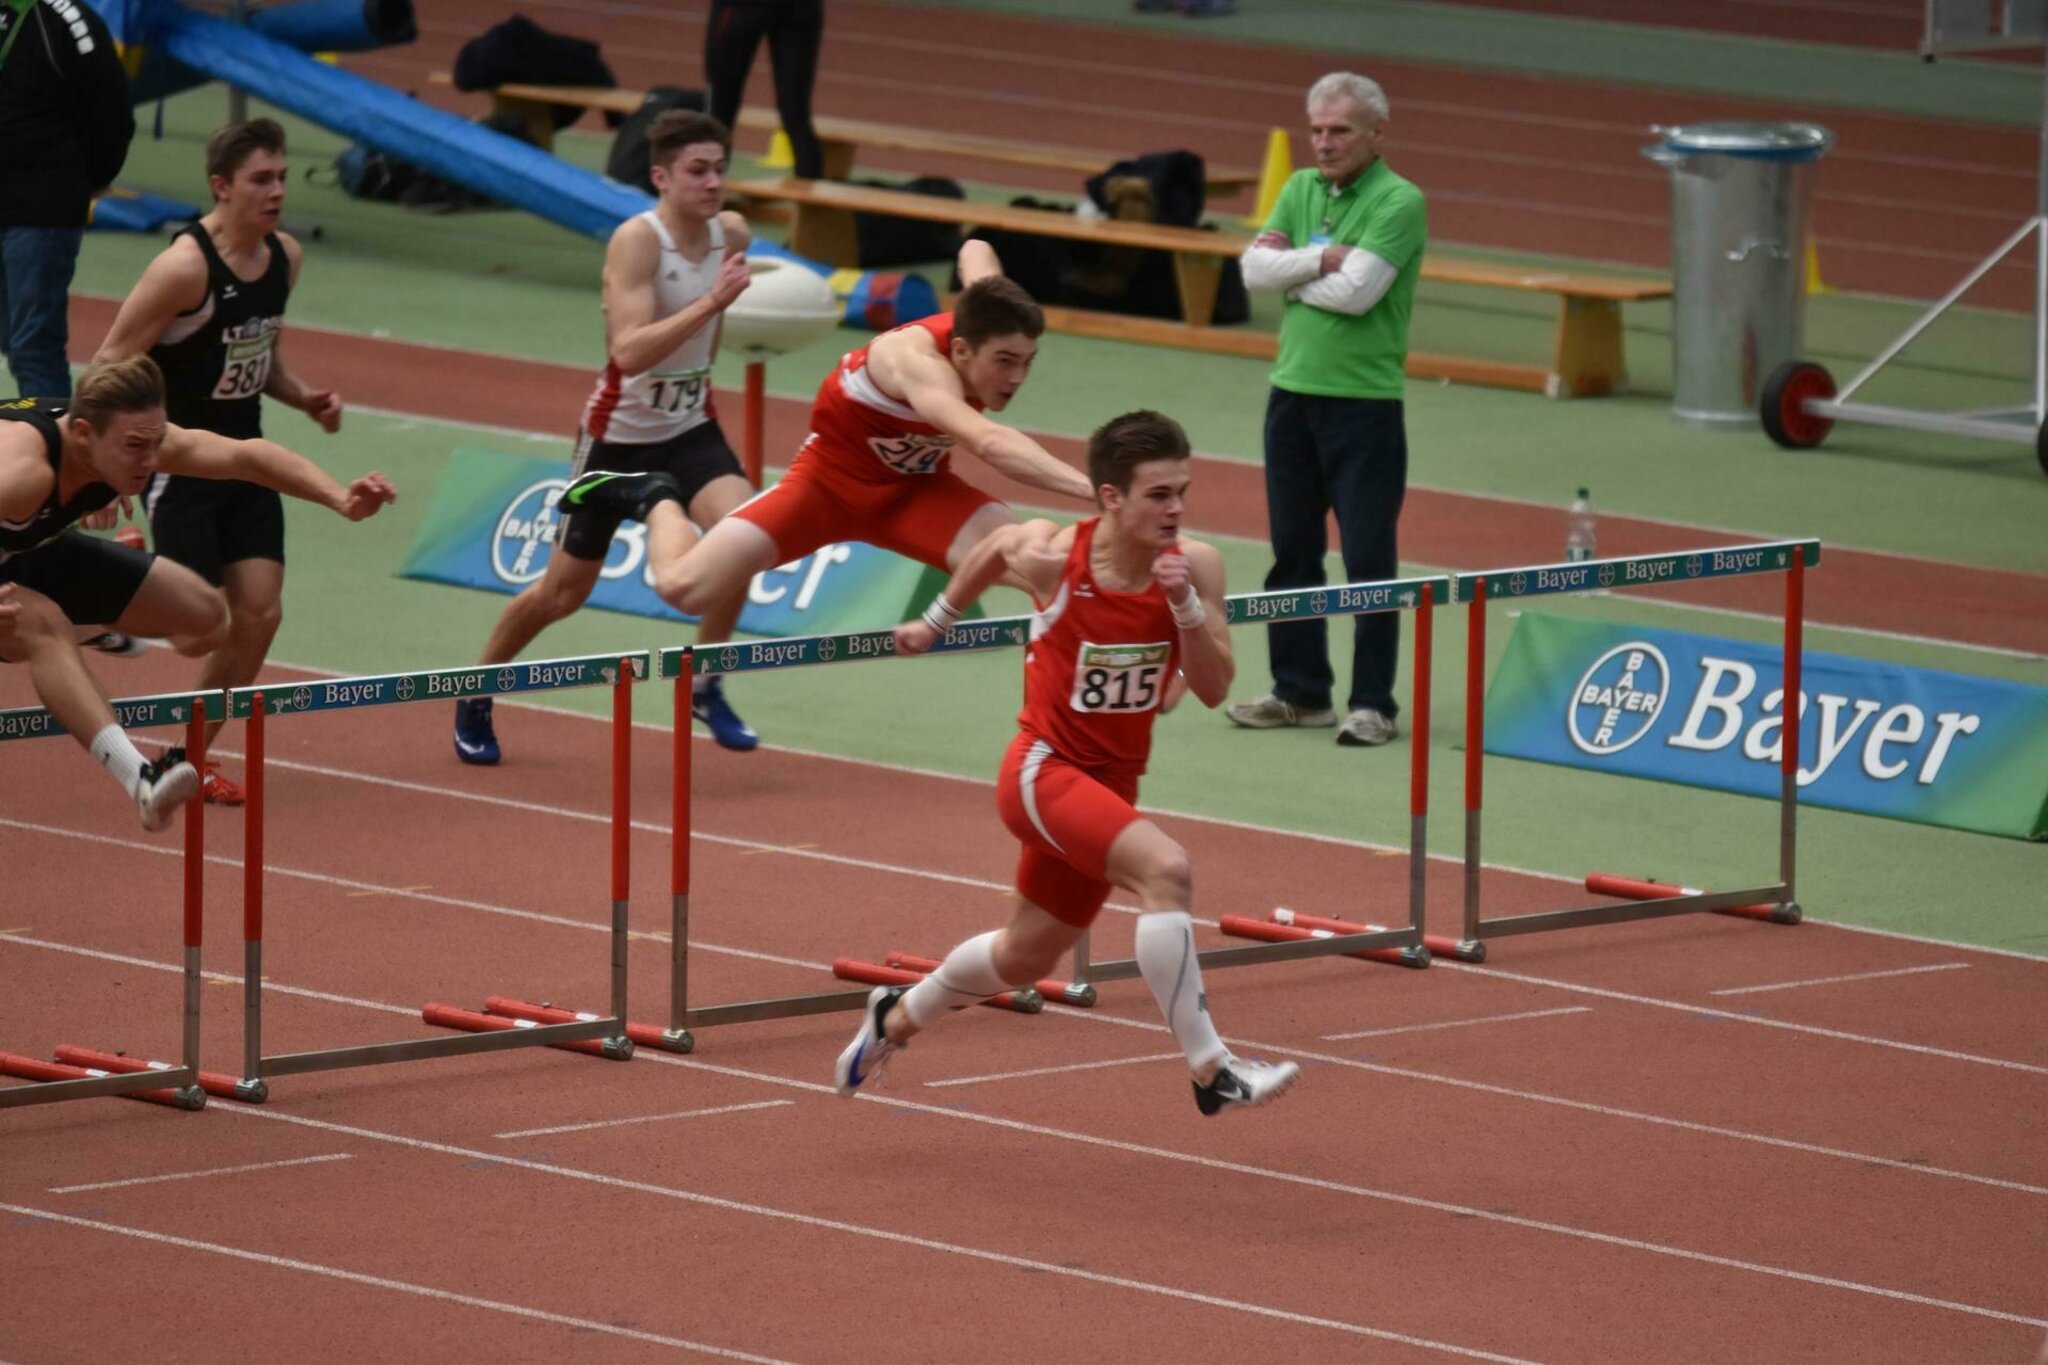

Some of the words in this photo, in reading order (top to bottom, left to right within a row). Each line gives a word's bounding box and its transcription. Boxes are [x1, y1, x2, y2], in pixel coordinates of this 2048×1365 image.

[219, 357, 266, 395] 381
[650, 376, 702, 413] 179
[503, 518, 558, 543] BAYE
[1536, 567, 1588, 590] Bayer
[1625, 558, 1676, 581] Bayer
[1713, 549, 1763, 572] Bayer
[750, 642, 806, 666] Bayer
[848, 635, 895, 656] Baye
[944, 626, 998, 647] Bayer
[1246, 597, 1299, 618] Bayer
[1339, 588, 1392, 609] Bayer
[324, 681, 383, 706] Bayer
[427, 672, 485, 695] Bayer
[527, 662, 585, 687] Bayer
[1081, 667, 1158, 710] 815
[1580, 684, 1659, 713] BAYER
[1593, 651, 1645, 747] BAYER
[113, 704, 157, 727] ayer
[1668, 656, 1980, 786] Bayer
